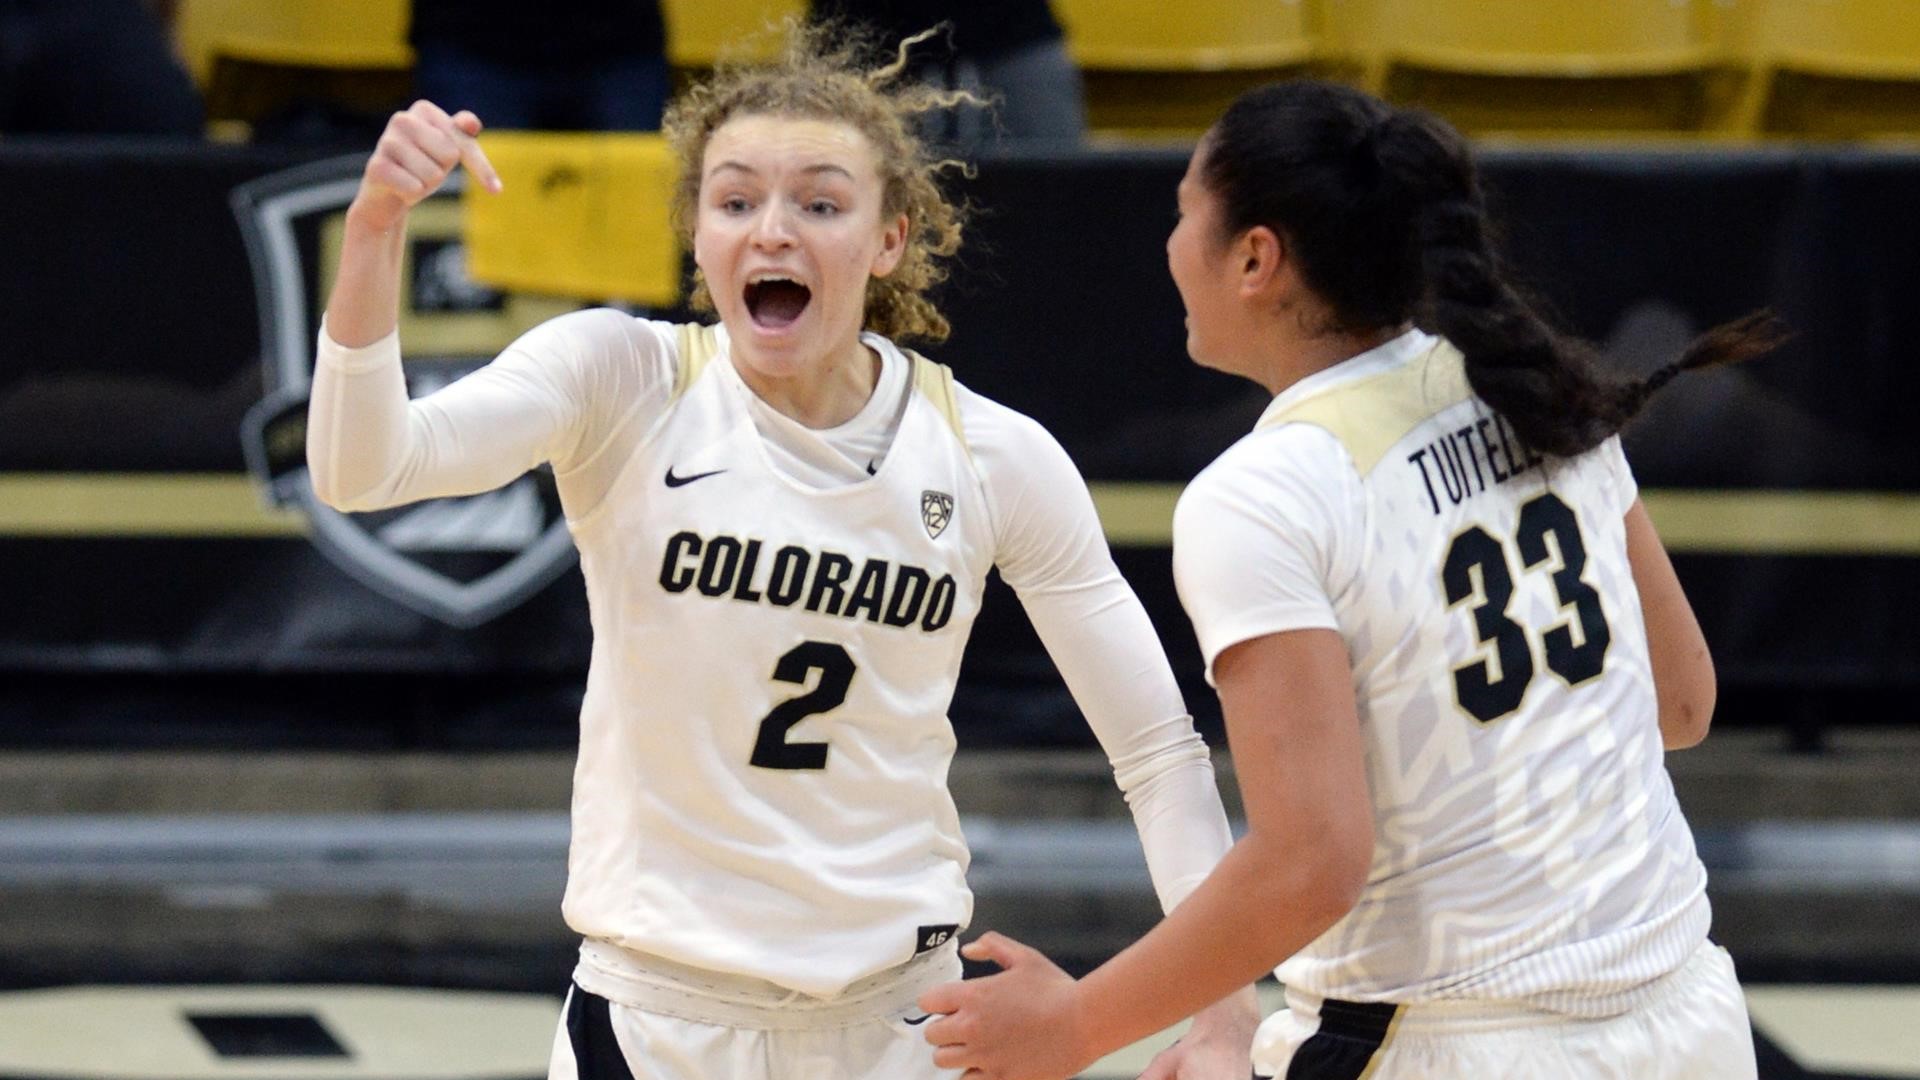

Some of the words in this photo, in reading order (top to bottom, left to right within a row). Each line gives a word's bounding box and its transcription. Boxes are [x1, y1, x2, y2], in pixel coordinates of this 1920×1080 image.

[926, 511, 942, 529] 12
[658, 531, 957, 632] COLORADO
[1442, 492, 1611, 723] 33
[750, 640, 856, 770] 2
[925, 931, 948, 947] 46
